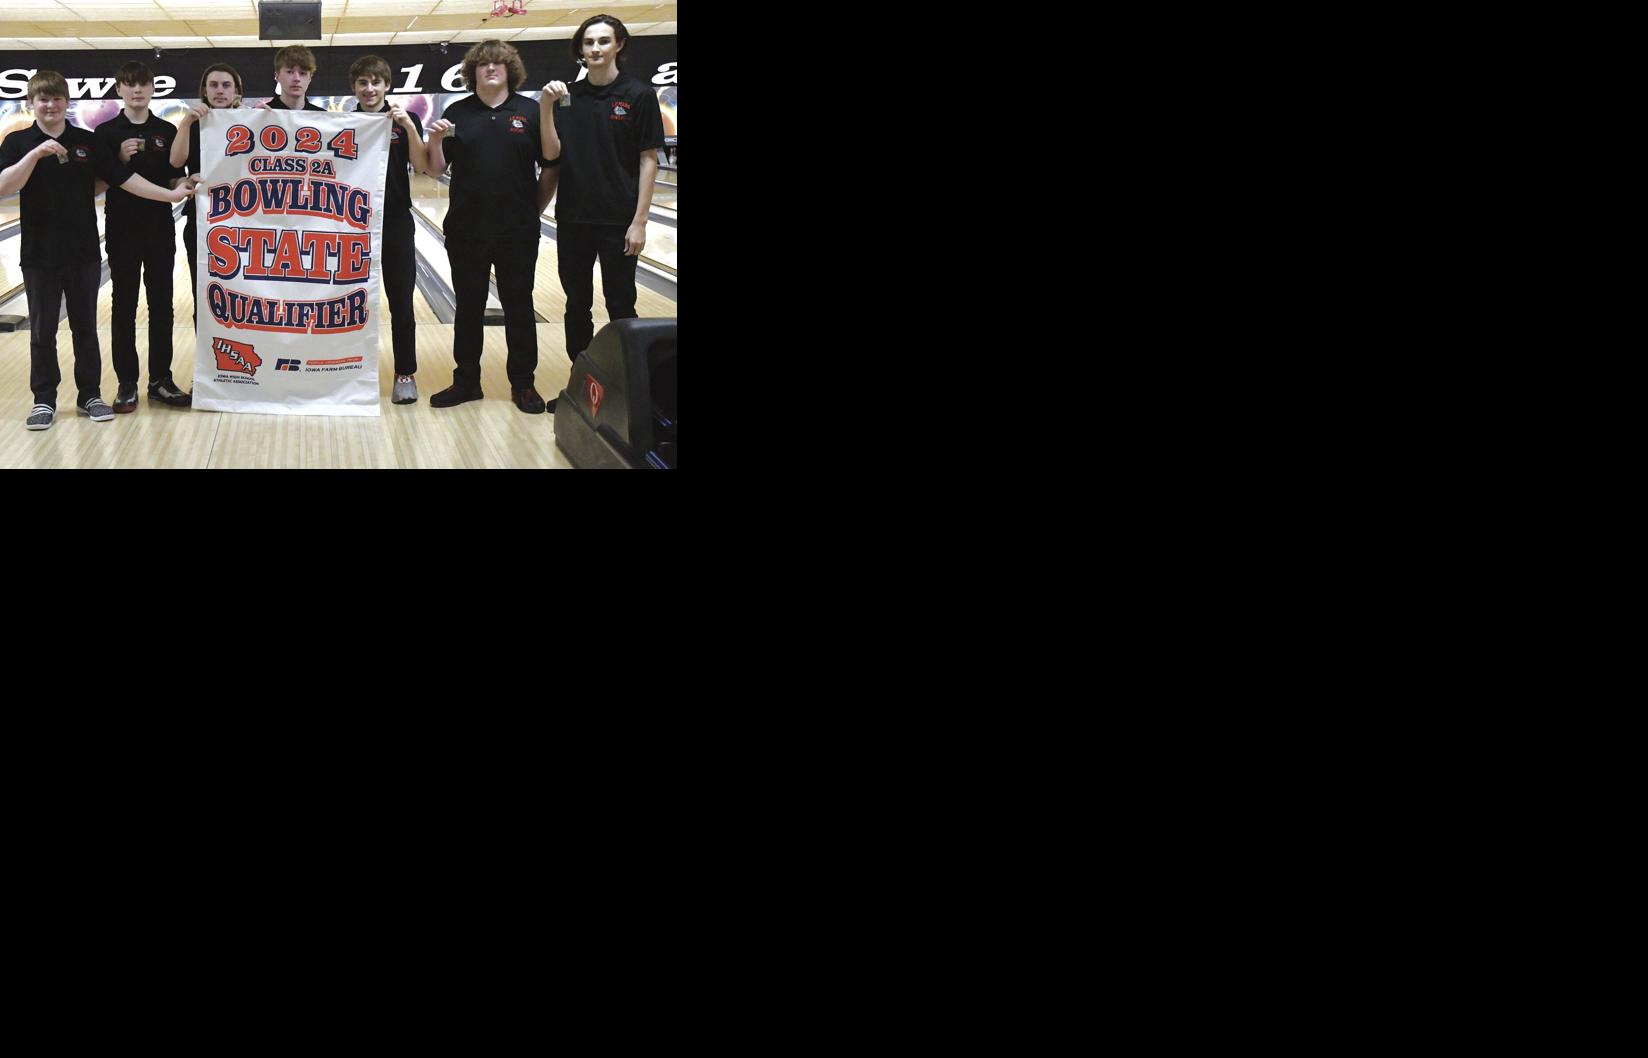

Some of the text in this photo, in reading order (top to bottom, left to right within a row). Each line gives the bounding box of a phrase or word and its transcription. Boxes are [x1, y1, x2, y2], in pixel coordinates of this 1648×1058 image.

[225, 124, 358, 160] 2024
[249, 157, 335, 178] CLASS 2A
[207, 178, 372, 230] BOWLING
[207, 225, 371, 285] STATE
[207, 281, 369, 334] QUALIFIER
[217, 340, 252, 371] IHSAA
